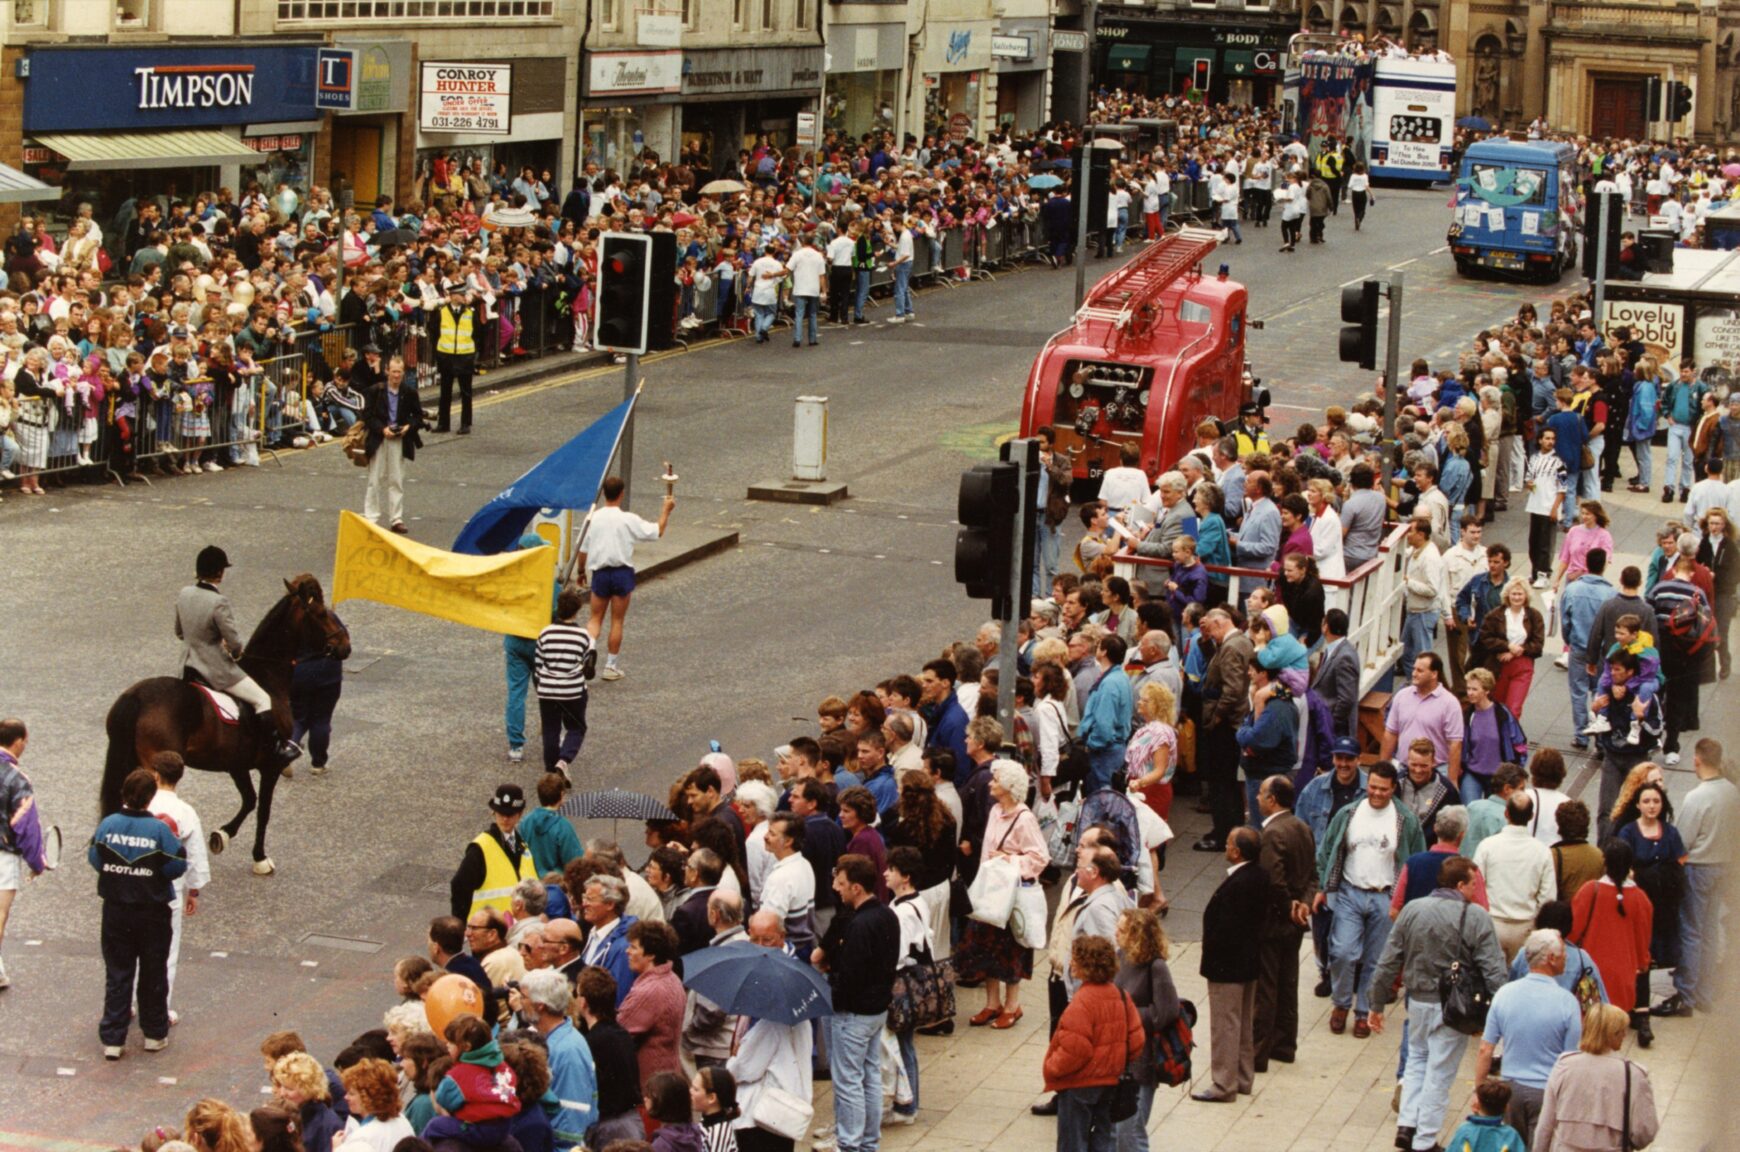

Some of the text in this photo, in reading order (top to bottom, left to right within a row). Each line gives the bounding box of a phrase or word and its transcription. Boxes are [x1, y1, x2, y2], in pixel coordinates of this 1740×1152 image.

[1096, 27, 1128, 37] SHOP
[1226, 33, 1259, 44] BODY
[436, 69, 497, 81] CONROY
[135, 66, 254, 108] TIMPSON
[436, 80, 496, 92] HUNTER
[319, 92, 350, 101] SHOES
[431, 116, 499, 128] 031-226 4791
[1609, 302, 1675, 330] Lovely
[105, 832, 157, 849] TAYSIDE
[103, 863, 153, 877] SCOTLAND
